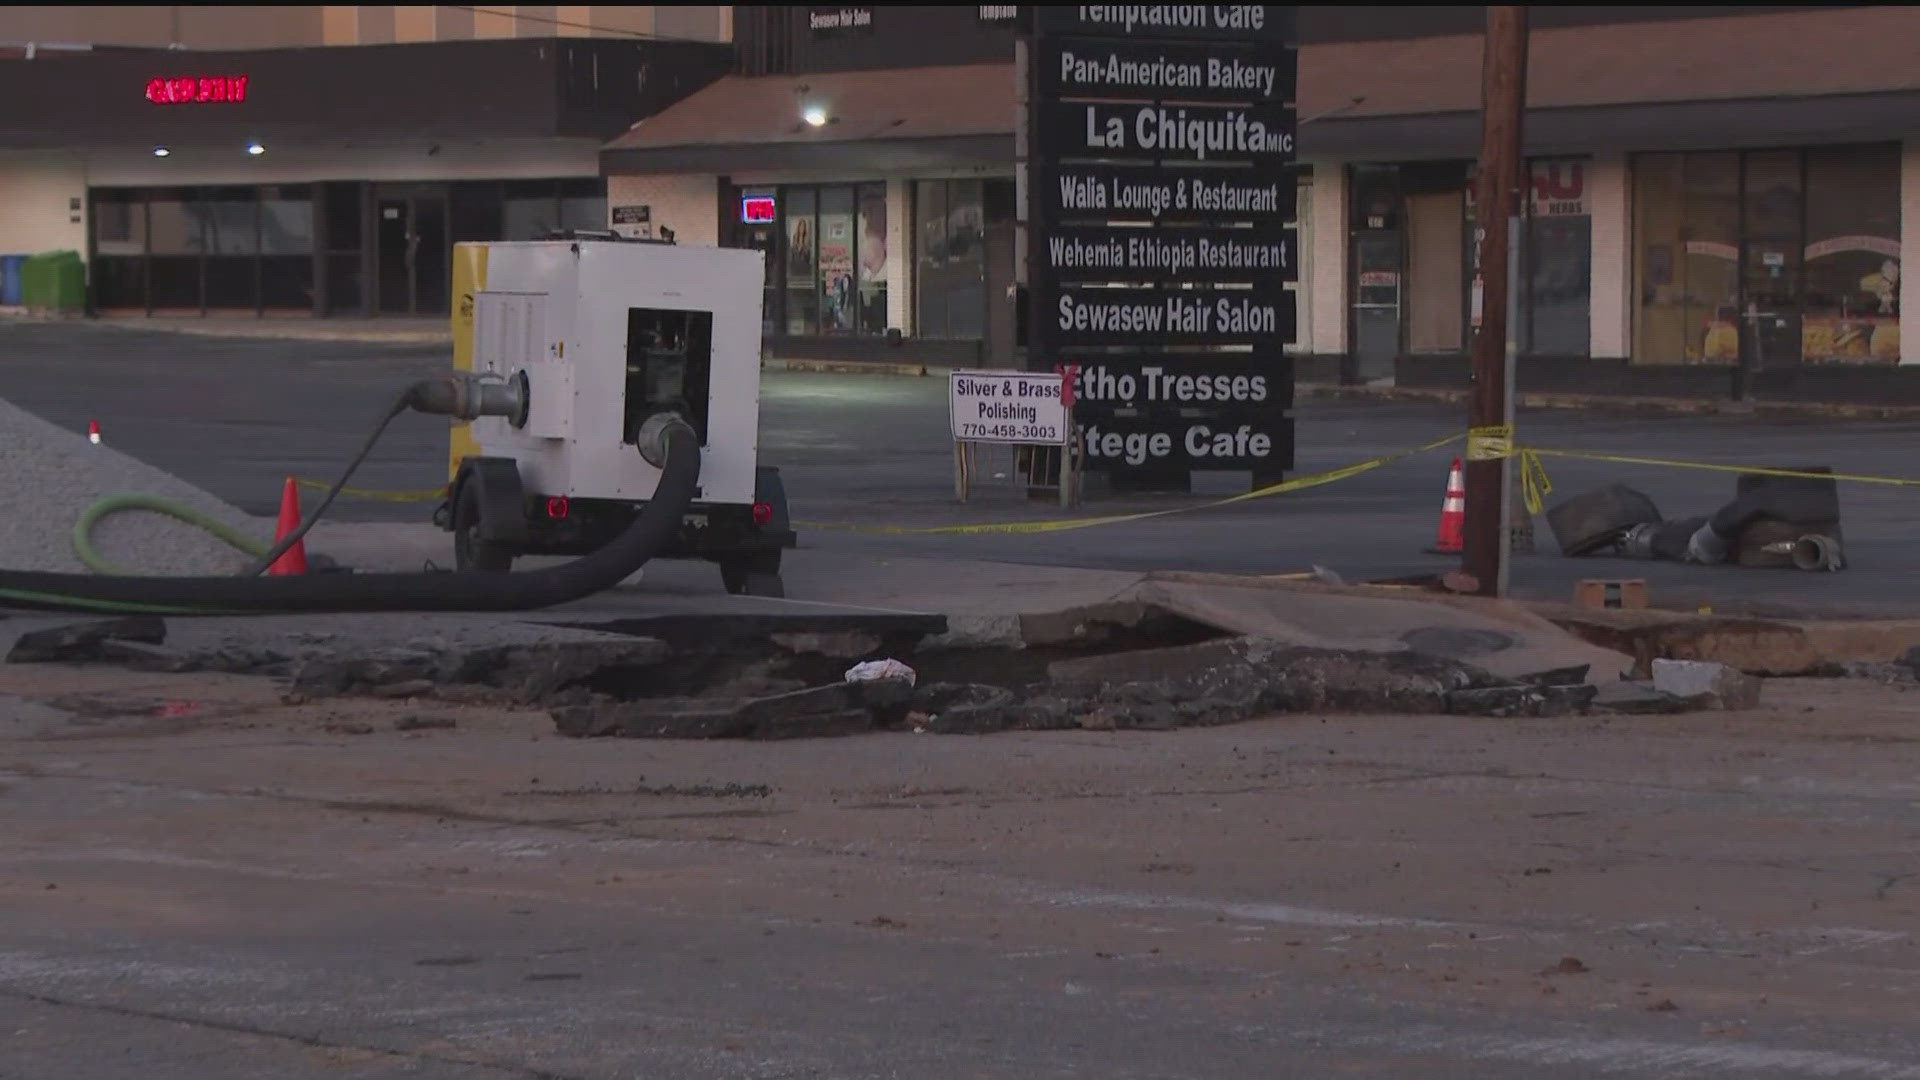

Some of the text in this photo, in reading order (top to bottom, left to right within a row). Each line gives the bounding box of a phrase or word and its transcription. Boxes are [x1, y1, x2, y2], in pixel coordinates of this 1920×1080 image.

[1060, 51, 1276, 97] Pan-American Bakery
[1086, 106, 1293, 160] La Chiquita MIC
[1059, 175, 1278, 217] Walia Lounge & Restaurant
[1049, 236, 1287, 275] Wehemia Ethiopia Restaurant
[1058, 294, 1276, 333] Sewasew Hair Salon
[957, 379, 1061, 398] Silver & Brass
[1141, 366, 1267, 401] Tresses
[962, 423, 1056, 439] 770-458-3003
[978, 401, 1037, 424] Polishing
[1184, 425, 1272, 457] Cafe
